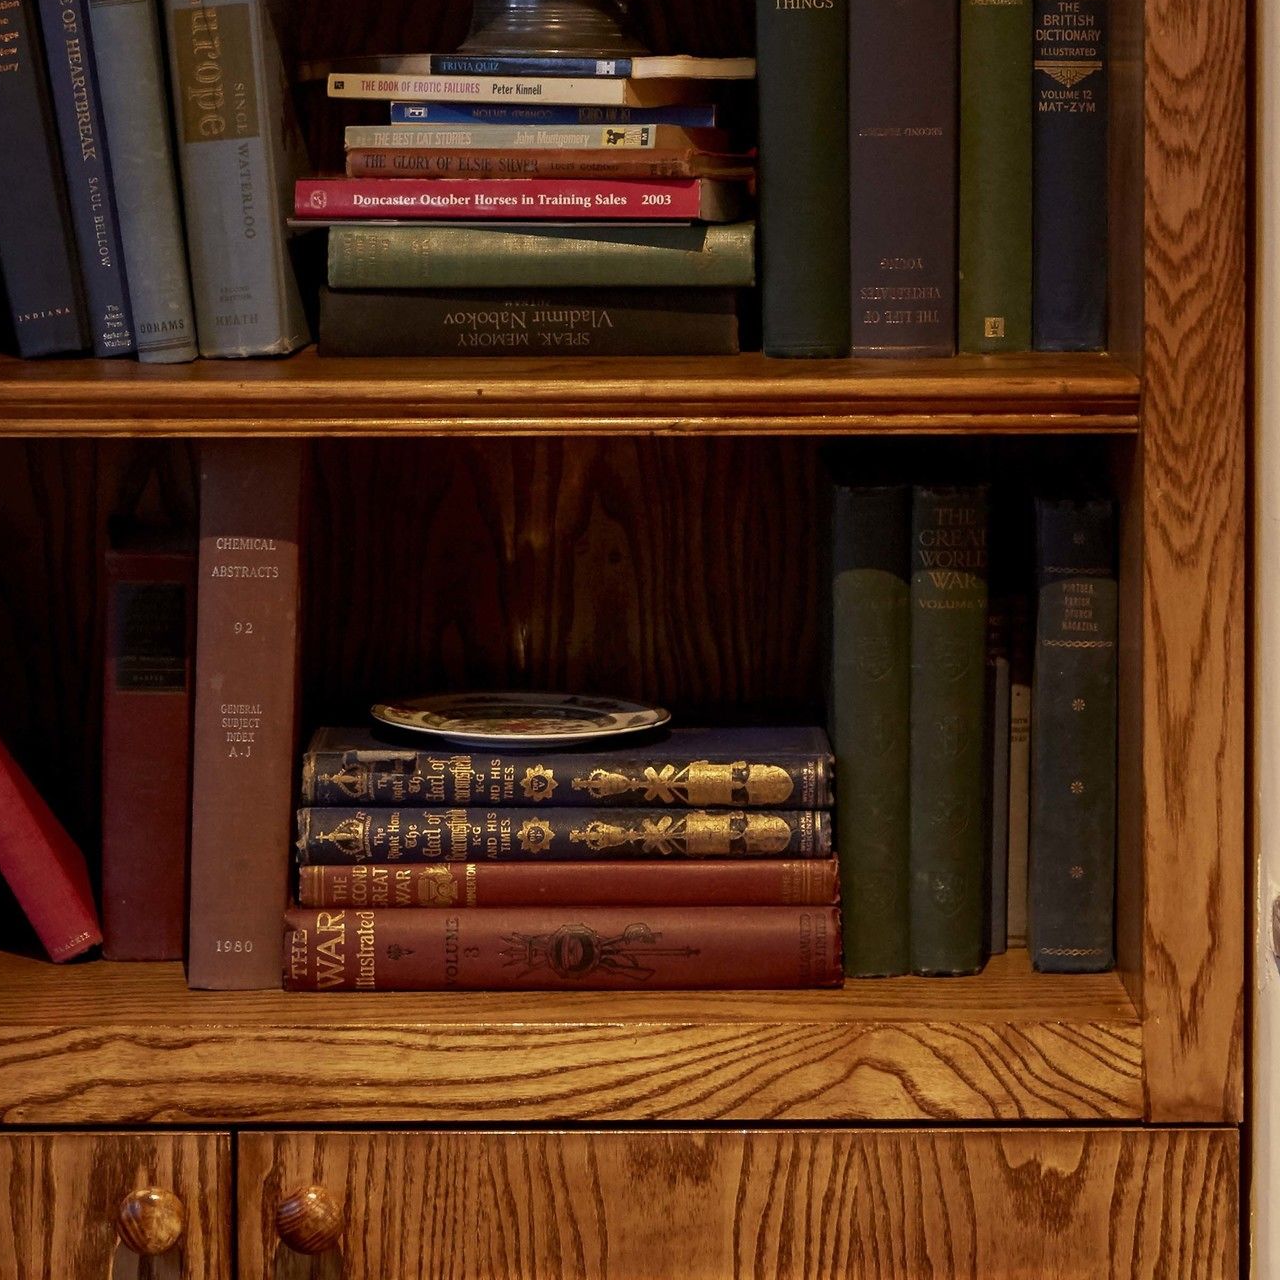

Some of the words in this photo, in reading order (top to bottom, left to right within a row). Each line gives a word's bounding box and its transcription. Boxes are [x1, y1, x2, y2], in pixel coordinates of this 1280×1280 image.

[1057, 1, 1080, 13] THE
[62, 8, 77, 33] OF
[1043, 14, 1095, 27] BRITISH
[1036, 29, 1101, 42] DICTIONARY
[1040, 46, 1097, 57] ILLUSTRATED
[442, 60, 473, 71] TRIVIA
[475, 60, 500, 72] QUIZ
[361, 81, 375, 92] THE
[377, 81, 399, 93] BOOK
[401, 81, 411, 93] OF
[414, 82, 439, 93] EROTIC
[441, 82, 480, 94] FAILURES
[492, 83, 513, 96] Peter
[515, 83, 543, 96] Kinnell
[1040, 89, 1079, 100] VOLUME
[1082, 89, 1093, 100] 12
[65, 38, 96, 162] HEARTBREAK
[234, 82, 249, 133] SINCE
[1038, 100, 1096, 113] MAT-ZYM
[374, 132, 395, 144] THE
[396, 132, 417, 144] BEST
[419, 132, 434, 144] CAT
[436, 131, 472, 145] STORIES
[513, 131, 535, 145] John
[537, 131, 591, 148] Montgomery
[364, 154, 387, 169] THE
[392, 154, 432, 171] GLORY
[436, 154, 452, 170] OF
[458, 154, 494, 171] ELSIE
[498, 154, 540, 172] SILVER
[88, 176, 102, 211] SAUL
[237, 142, 257, 239] WATERLOO
[352, 193, 417, 206] Doncaster
[420, 193, 468, 206] October
[474, 193, 518, 206] Horses
[521, 193, 534, 206] in
[538, 193, 592, 209] Training
[595, 193, 627, 206] Sales
[641, 193, 672, 206] 2003
[94, 215, 111, 267] BELLOW
[17, 307, 71, 322] INDIANA
[443, 308, 526, 327] Nabokov
[533, 307, 614, 328] Vladimir
[139, 318, 185, 333] ODHAMS
[457, 332, 530, 347] MEMORY
[934, 507, 976, 526] THE
[215, 537, 277, 552] CHEMICAL
[211, 565, 280, 579] ABSTRACTS
[927, 572, 980, 590] WAR
[919, 599, 974, 609] VOLUME
[233, 621, 254, 635] 92
[220, 704, 263, 716] GENERAL
[221, 718, 261, 729] SUBJECT
[226, 731, 255, 743] INDEX
[428, 757, 449, 771] of
[489, 758, 501, 779] HIS
[422, 811, 446, 824] of
[487, 811, 498, 833] HIS
[374, 827, 384, 847] The
[487, 836, 498, 860] AND
[333, 876, 347, 902] THE
[396, 869, 411, 904] WAR
[215, 939, 254, 953] 1980
[316, 910, 346, 989] WAR
[355, 910, 375, 990] Illustrated
[445, 917, 459, 987] VOLUME
[291, 928, 308, 980] THE
